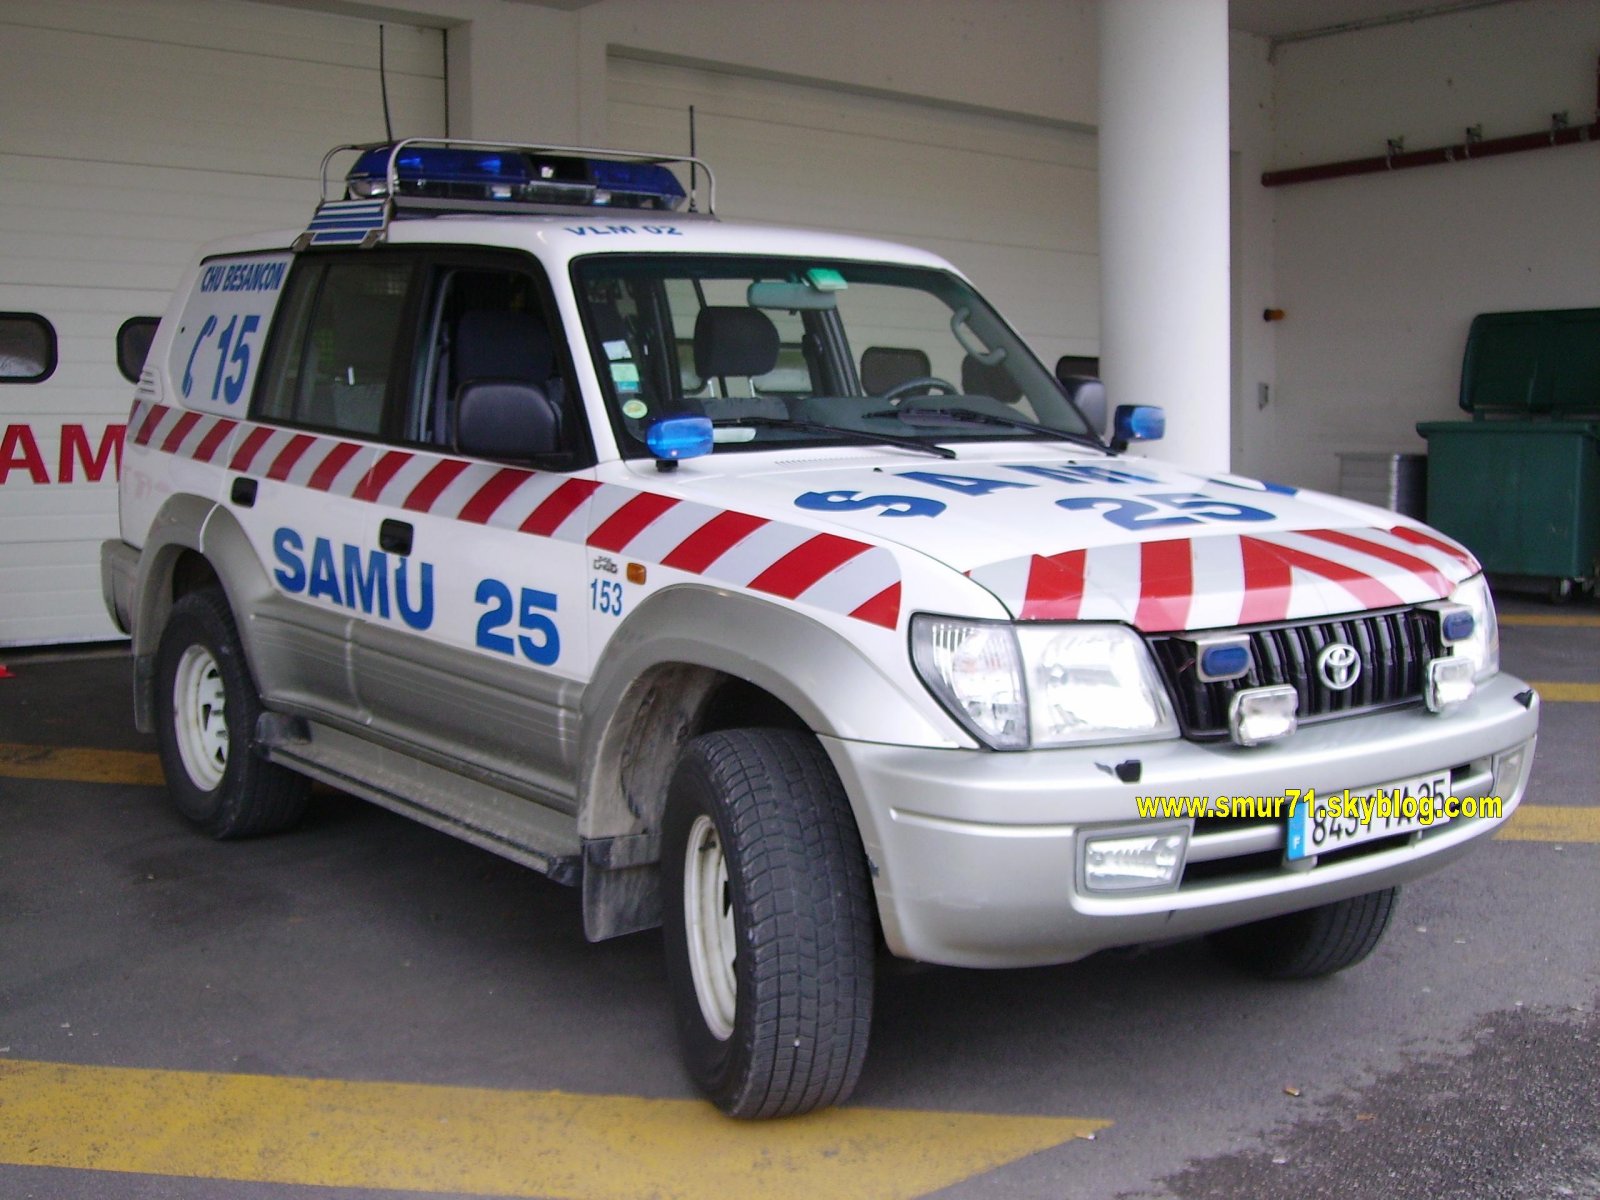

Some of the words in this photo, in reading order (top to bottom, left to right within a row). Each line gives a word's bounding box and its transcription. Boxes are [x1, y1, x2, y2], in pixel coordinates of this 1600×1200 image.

[564, 225, 637, 236] VLM
[641, 225, 683, 236] 02
[201, 265, 226, 293] CHU
[212, 314, 261, 405] 15
[1054, 492, 1277, 531] 25
[272, 527, 434, 631] SAMU
[474, 578, 560, 667] 25
[591, 578, 623, 617] 153
